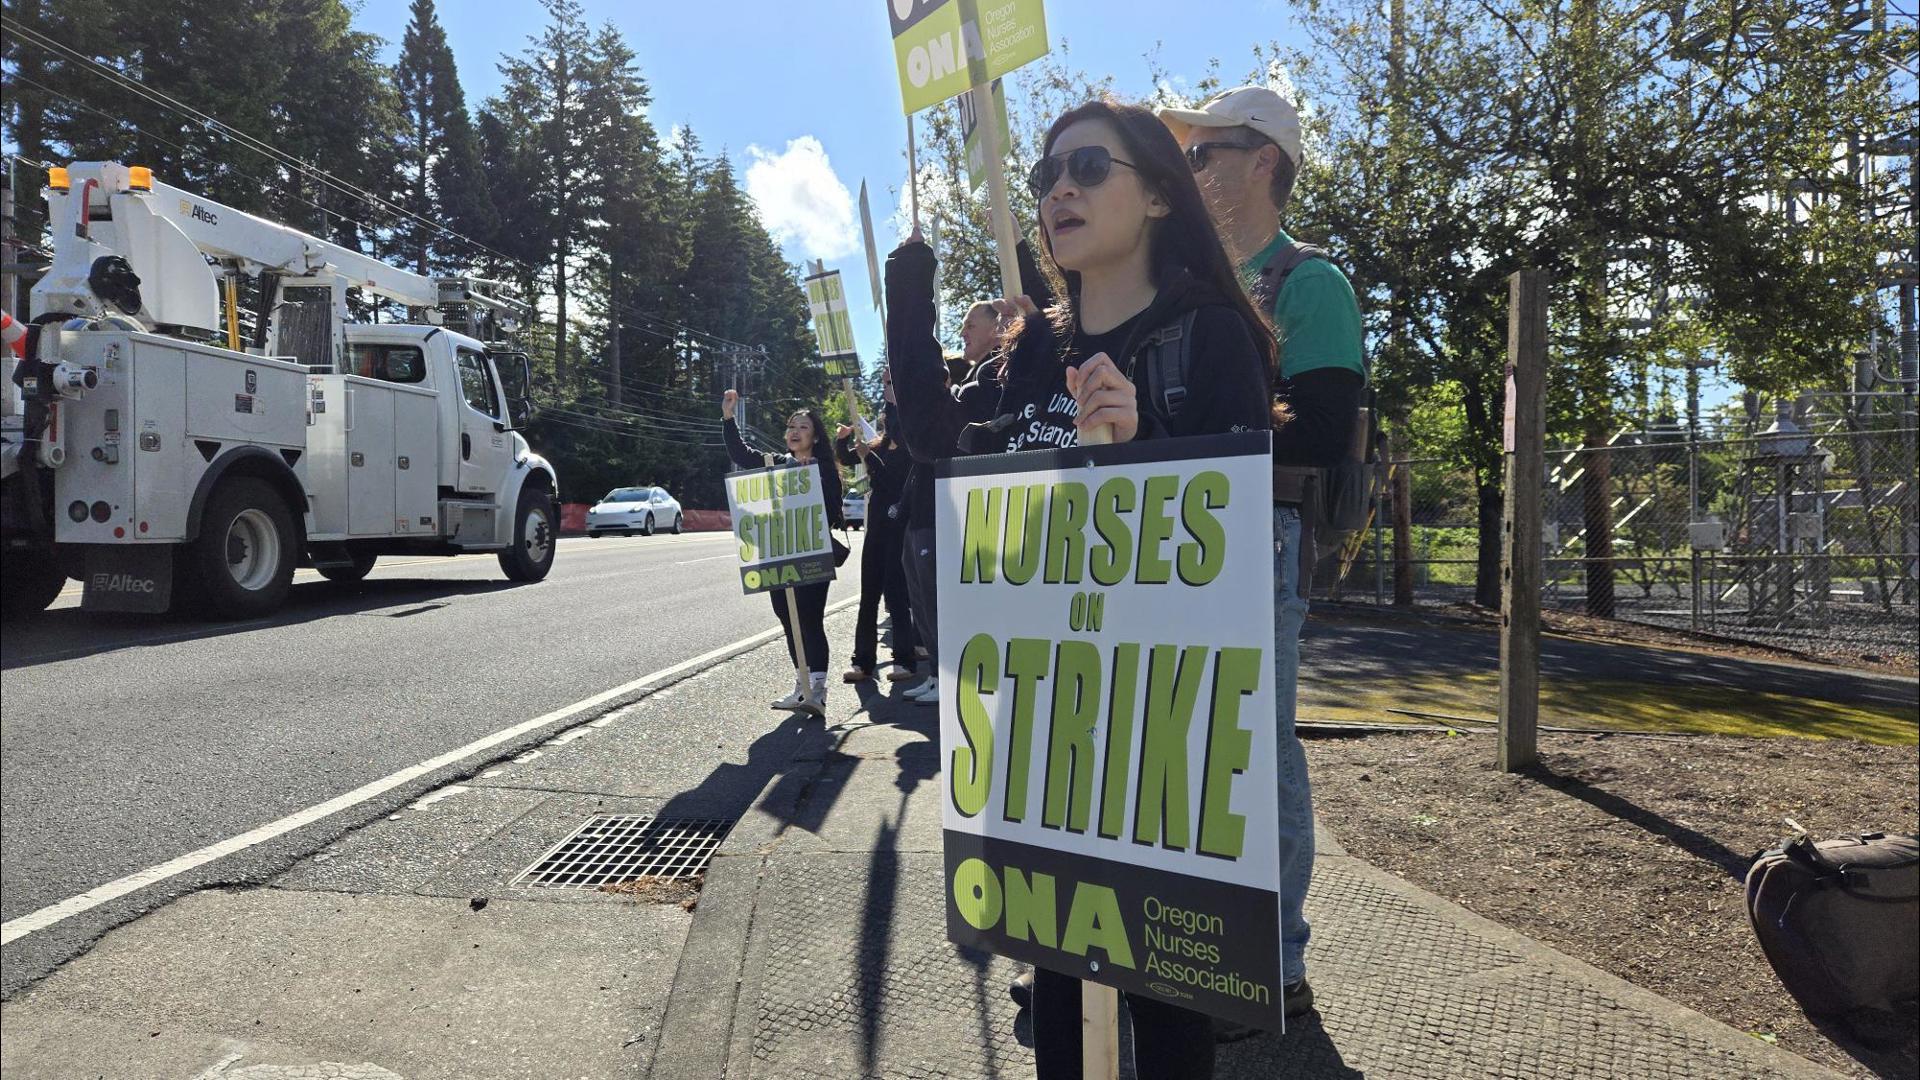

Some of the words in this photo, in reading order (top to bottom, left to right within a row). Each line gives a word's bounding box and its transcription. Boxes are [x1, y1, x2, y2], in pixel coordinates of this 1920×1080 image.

[906, 20, 985, 88] ONA
[192, 203, 218, 226] Altec
[736, 468, 811, 504] NURSES
[739, 504, 824, 562] STRIKE
[960, 470, 1230, 587] NURSES
[108, 574, 154, 593] Altec
[744, 564, 801, 589] ONA
[1069, 592, 1105, 632] ON
[950, 633, 1262, 862] STRIKE
[953, 857, 1136, 970] ONA
[1143, 896, 1223, 936] Oregon
[1144, 924, 1220, 964] Nurses
[1145, 951, 1270, 1005] Association
